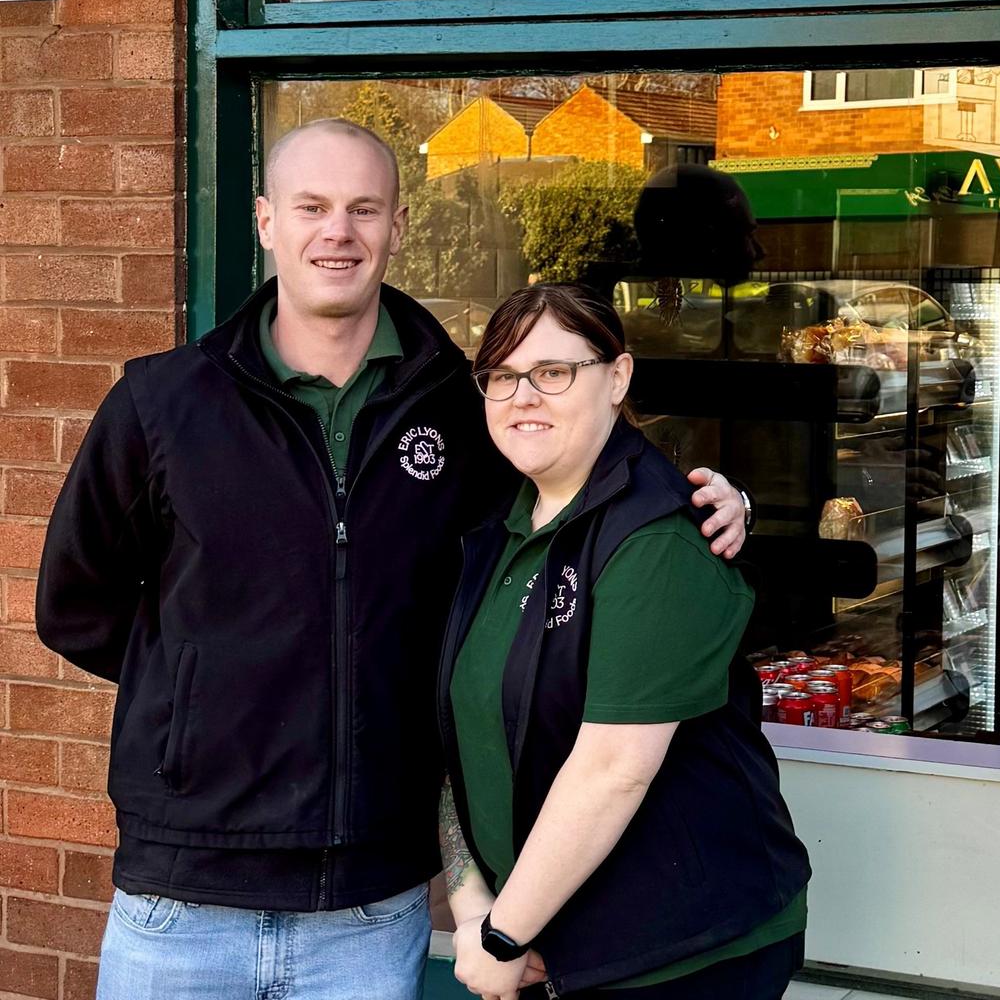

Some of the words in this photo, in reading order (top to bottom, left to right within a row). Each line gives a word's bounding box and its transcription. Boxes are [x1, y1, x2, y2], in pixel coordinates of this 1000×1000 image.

[397, 428, 418, 451] ERIC
[417, 426, 445, 452] LYONS
[399, 455, 430, 481] Splendid
[430, 455, 446, 480] Foods
[413, 451, 436, 465] 1903
[561, 565, 578, 592] YONS
